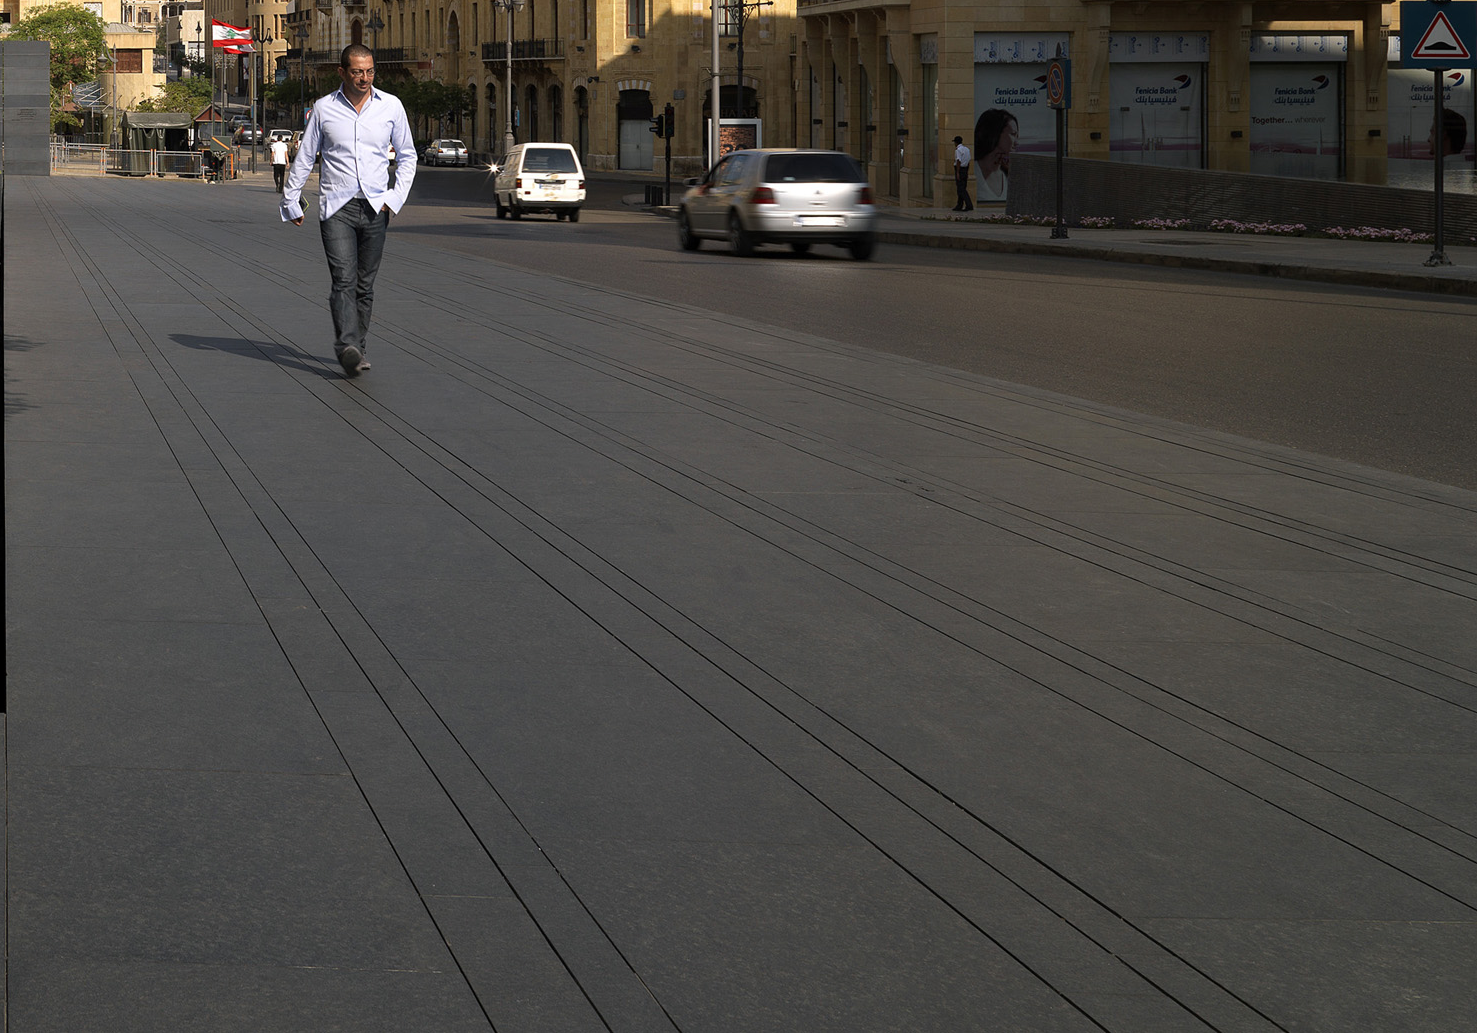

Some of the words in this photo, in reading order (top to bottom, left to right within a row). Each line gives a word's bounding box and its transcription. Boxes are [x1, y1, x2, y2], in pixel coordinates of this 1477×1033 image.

[995, 87, 1018, 95] Fenicia
[1020, 87, 1037, 95] Bank
[1275, 87, 1297, 95] Fenicia
[1299, 87, 1315, 95] Bank
